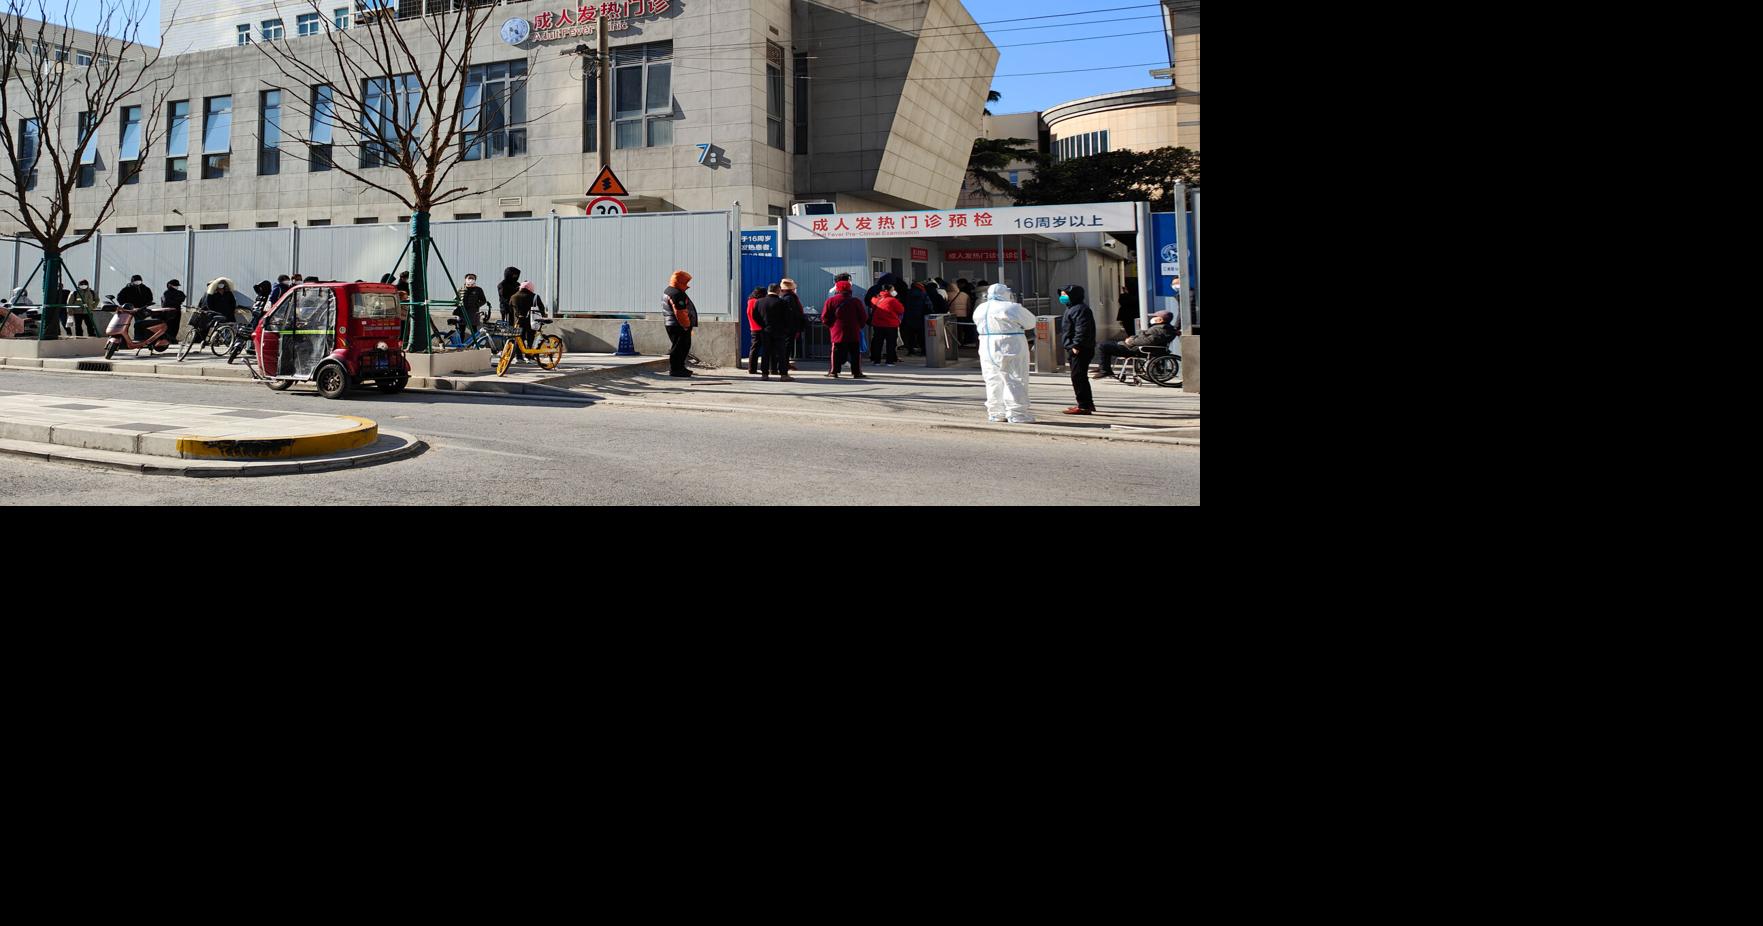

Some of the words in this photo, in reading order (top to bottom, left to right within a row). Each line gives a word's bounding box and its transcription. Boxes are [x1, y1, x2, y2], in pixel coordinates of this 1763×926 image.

[532, 0, 670, 31] 成人发热门诊
[531, 29, 561, 42] Adult
[561, 25, 595, 38] Fever
[812, 212, 993, 232] 成人发热门诊预检
[1014, 214, 1104, 229] 16周岁以上
